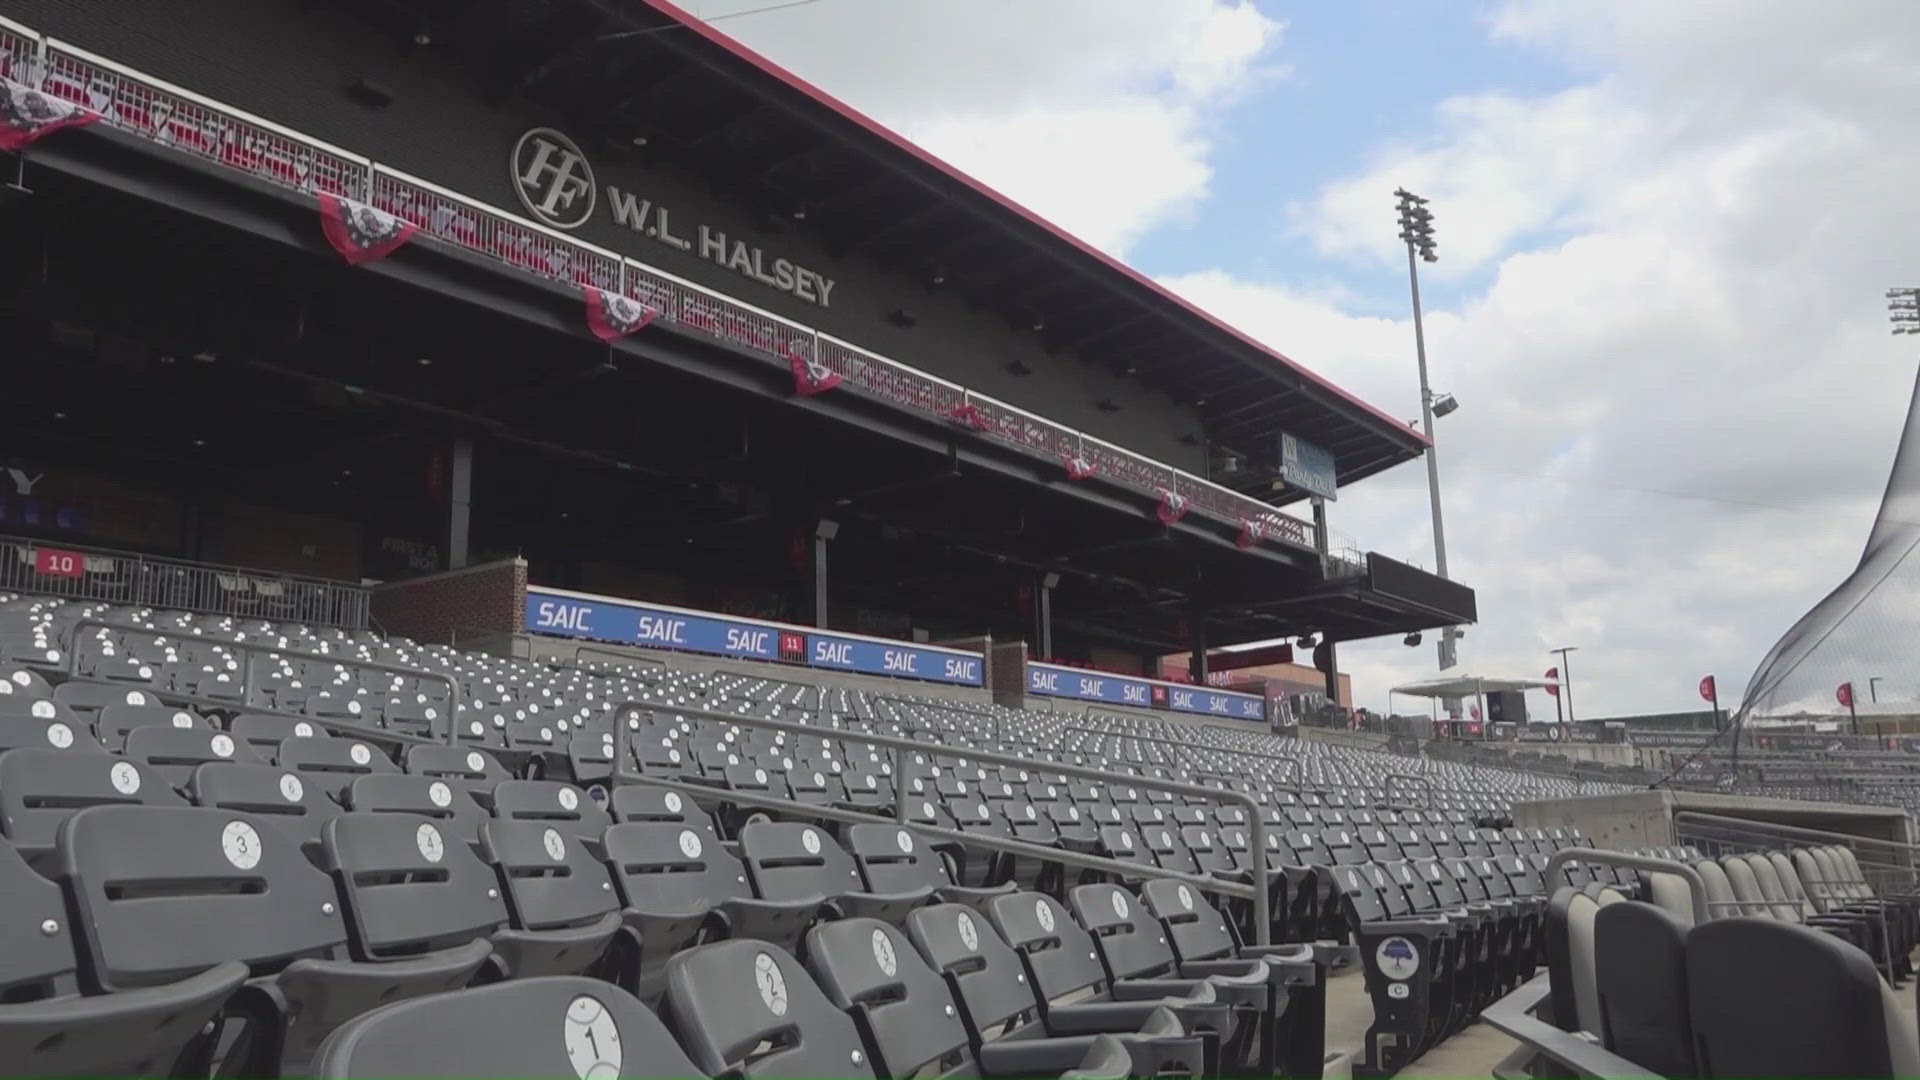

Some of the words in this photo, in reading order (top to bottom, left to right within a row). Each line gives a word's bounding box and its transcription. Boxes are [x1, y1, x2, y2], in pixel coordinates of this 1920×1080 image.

[606, 185, 691, 250] W.L.
[698, 224, 835, 308] HALSEY
[49, 554, 73, 573] 10
[537, 602, 594, 631] SAIC
[637, 616, 687, 643] SAIC
[726, 630, 769, 653] SAIC
[787, 639, 799, 650] 11
[815, 641, 853, 665] SAIC
[883, 651, 917, 673] SAIC
[945, 660, 976, 680] SAIC
[1032, 672, 1059, 691] SAIC
[1080, 679, 1104, 697] SAIC
[1124, 685, 1145, 702] SAIC
[1173, 692, 1193, 708] SAIC
[1210, 697, 1229, 712] SAIC
[1243, 701, 1262, 717] SAIC
[121, 771, 130, 784] 5
[236, 835, 248, 854] 3
[427, 836, 435, 850] 4
[551, 837, 559, 851] 5
[879, 942, 889, 962] 3
[766, 972, 778, 997] 2
[1394, 985, 1402, 995] C
[584, 1025, 600, 1060] 1
